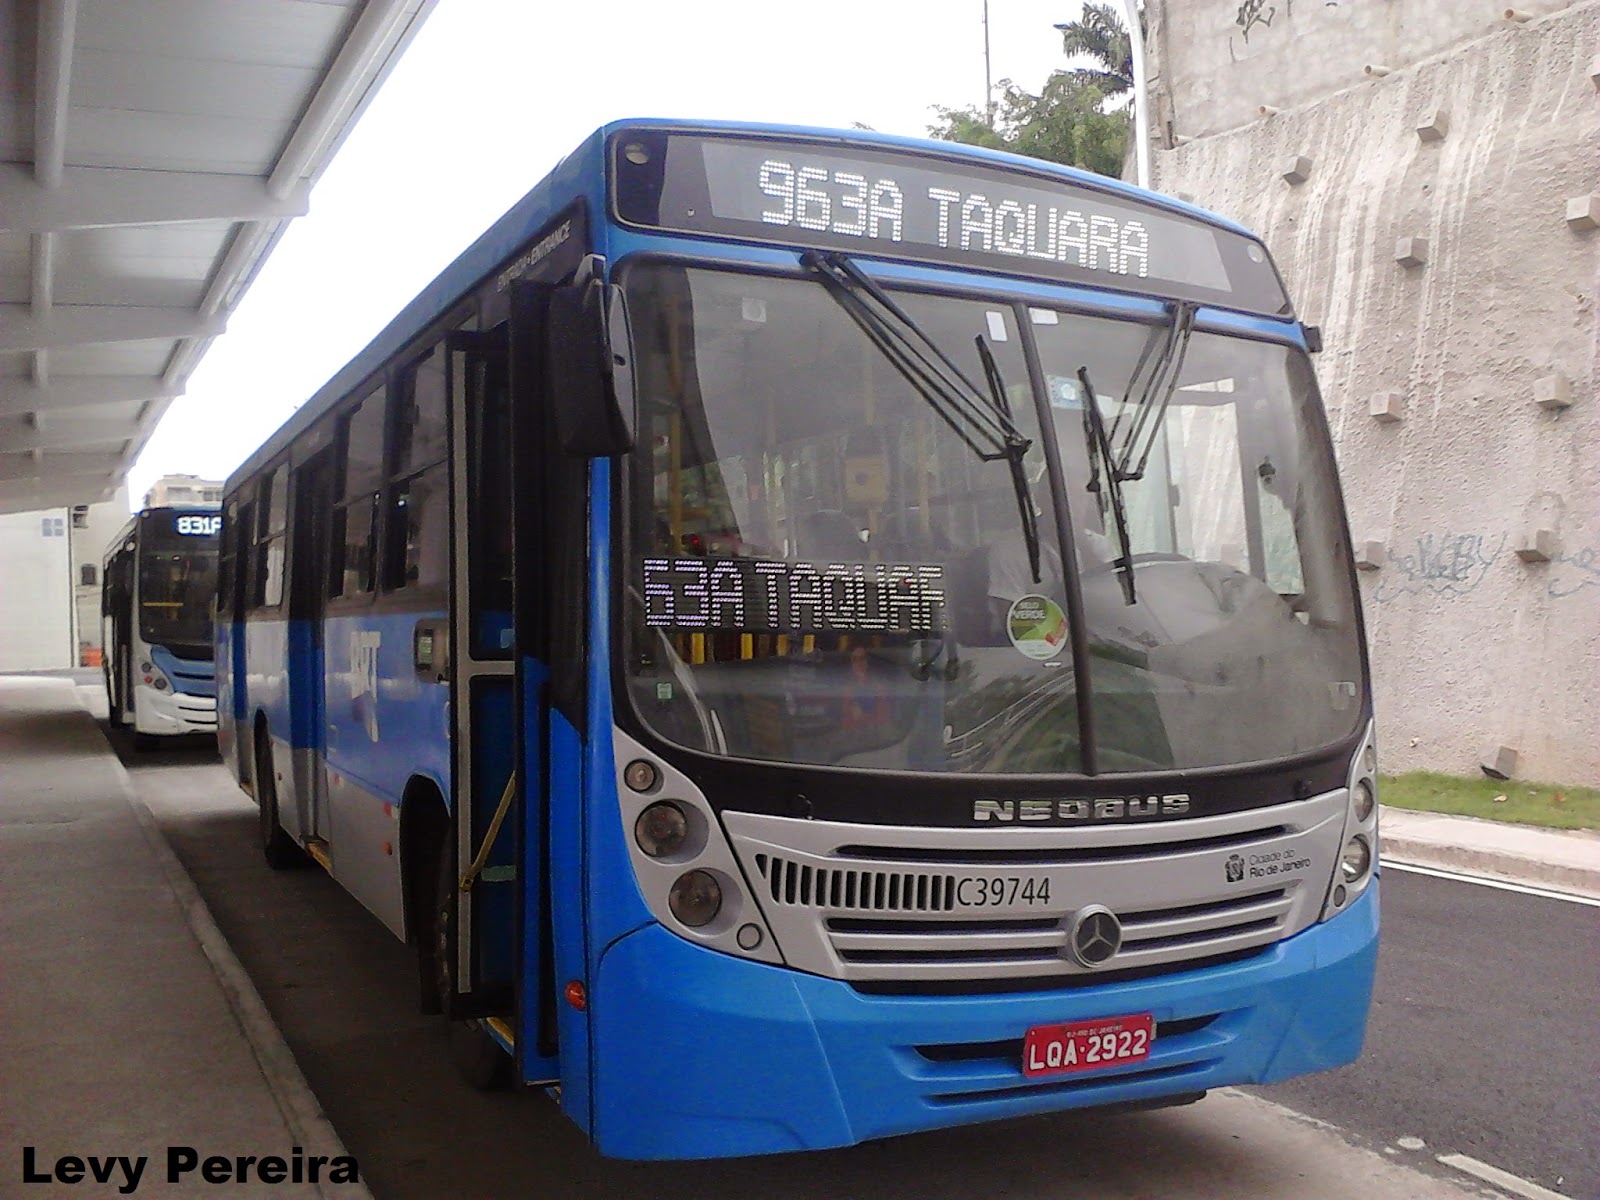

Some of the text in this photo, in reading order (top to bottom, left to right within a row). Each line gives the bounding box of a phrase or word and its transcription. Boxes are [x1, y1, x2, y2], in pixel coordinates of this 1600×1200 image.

[759, 160, 1149, 278] 963A TAQUARA
[643, 558, 744, 628] 63A
[1013, 610, 1046, 619] VERDE
[973, 794, 1190, 821] NEOBUS
[1250, 857, 1311, 879] Rio de Janeiro
[957, 877, 1051, 907] C39744
